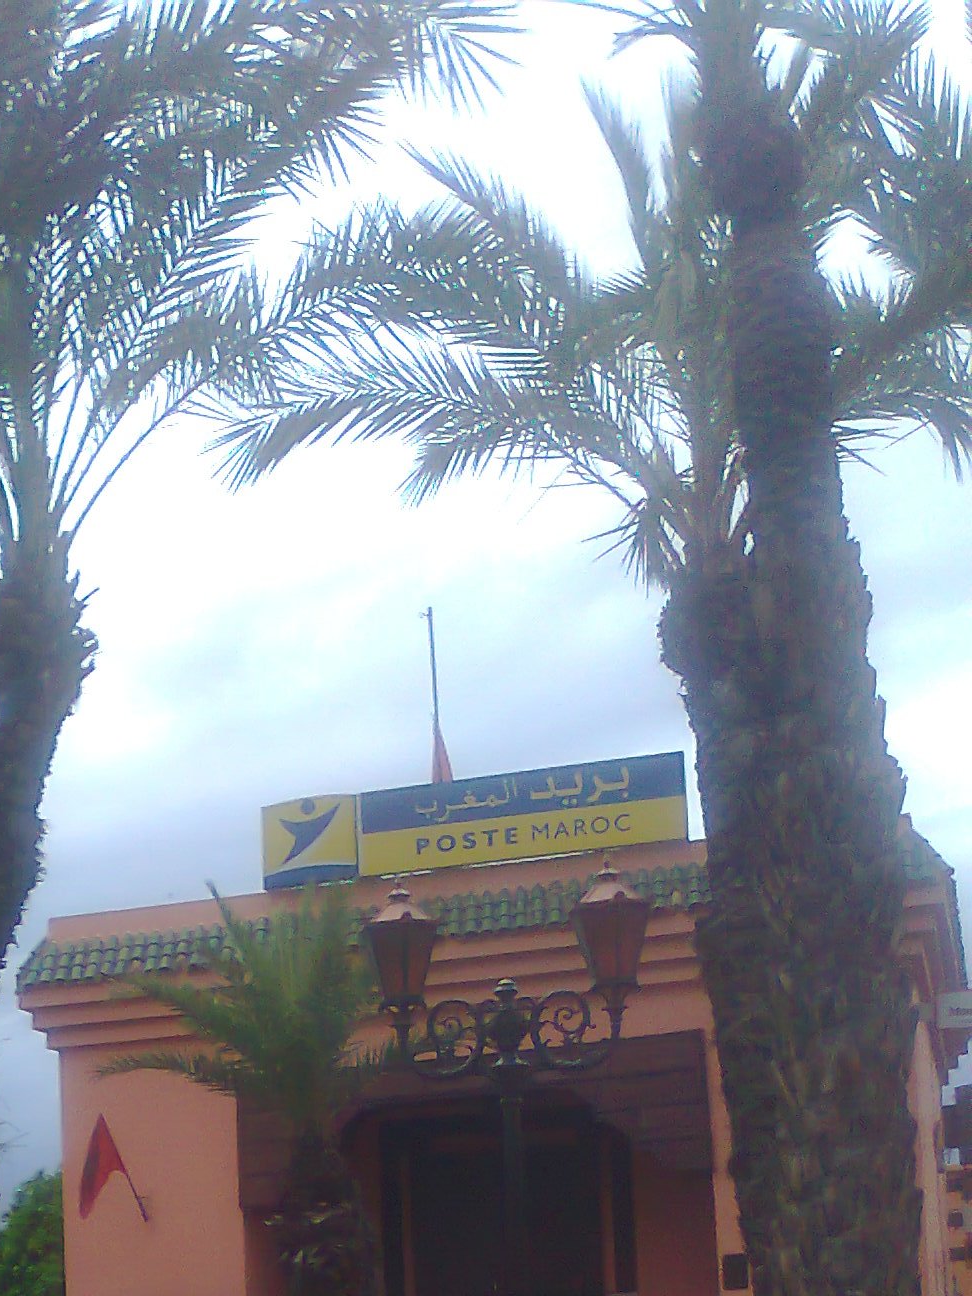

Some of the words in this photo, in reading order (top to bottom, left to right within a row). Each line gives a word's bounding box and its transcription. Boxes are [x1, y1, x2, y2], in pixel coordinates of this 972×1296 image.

[415, 776, 518, 822] المغرب
[529, 766, 629, 805] بريد
[415, 826, 518, 855] POSTE
[531, 813, 631, 841] MAROC
